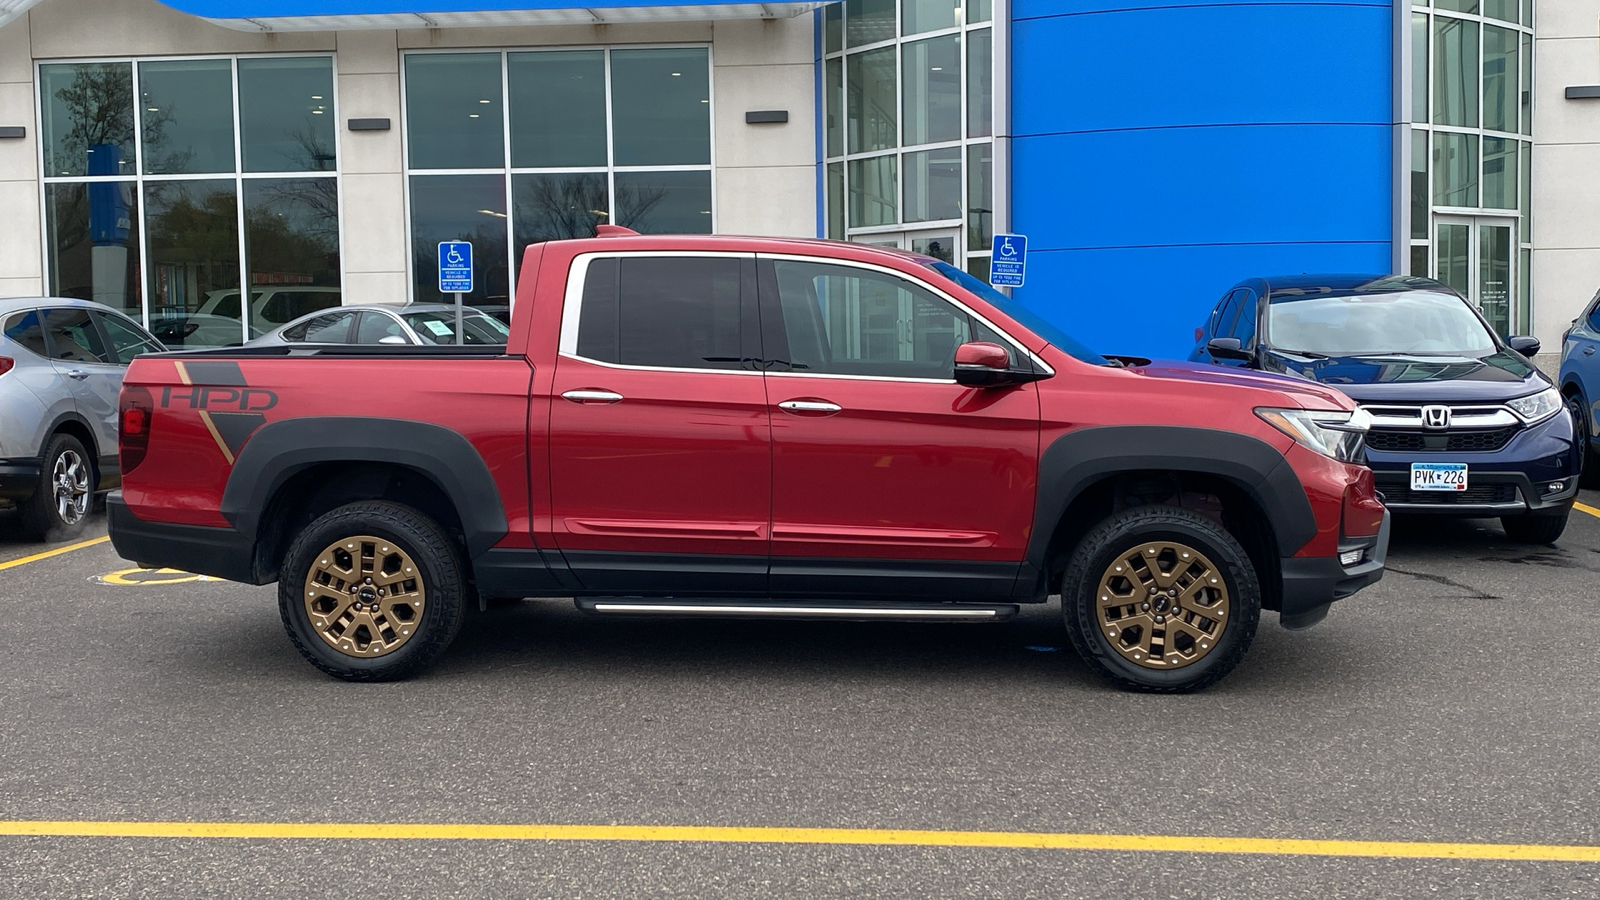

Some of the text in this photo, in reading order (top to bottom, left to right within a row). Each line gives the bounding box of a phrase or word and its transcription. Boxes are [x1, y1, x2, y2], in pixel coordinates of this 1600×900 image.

[161, 386, 279, 411] HPD
[1415, 470, 1464, 484] PVK 226
